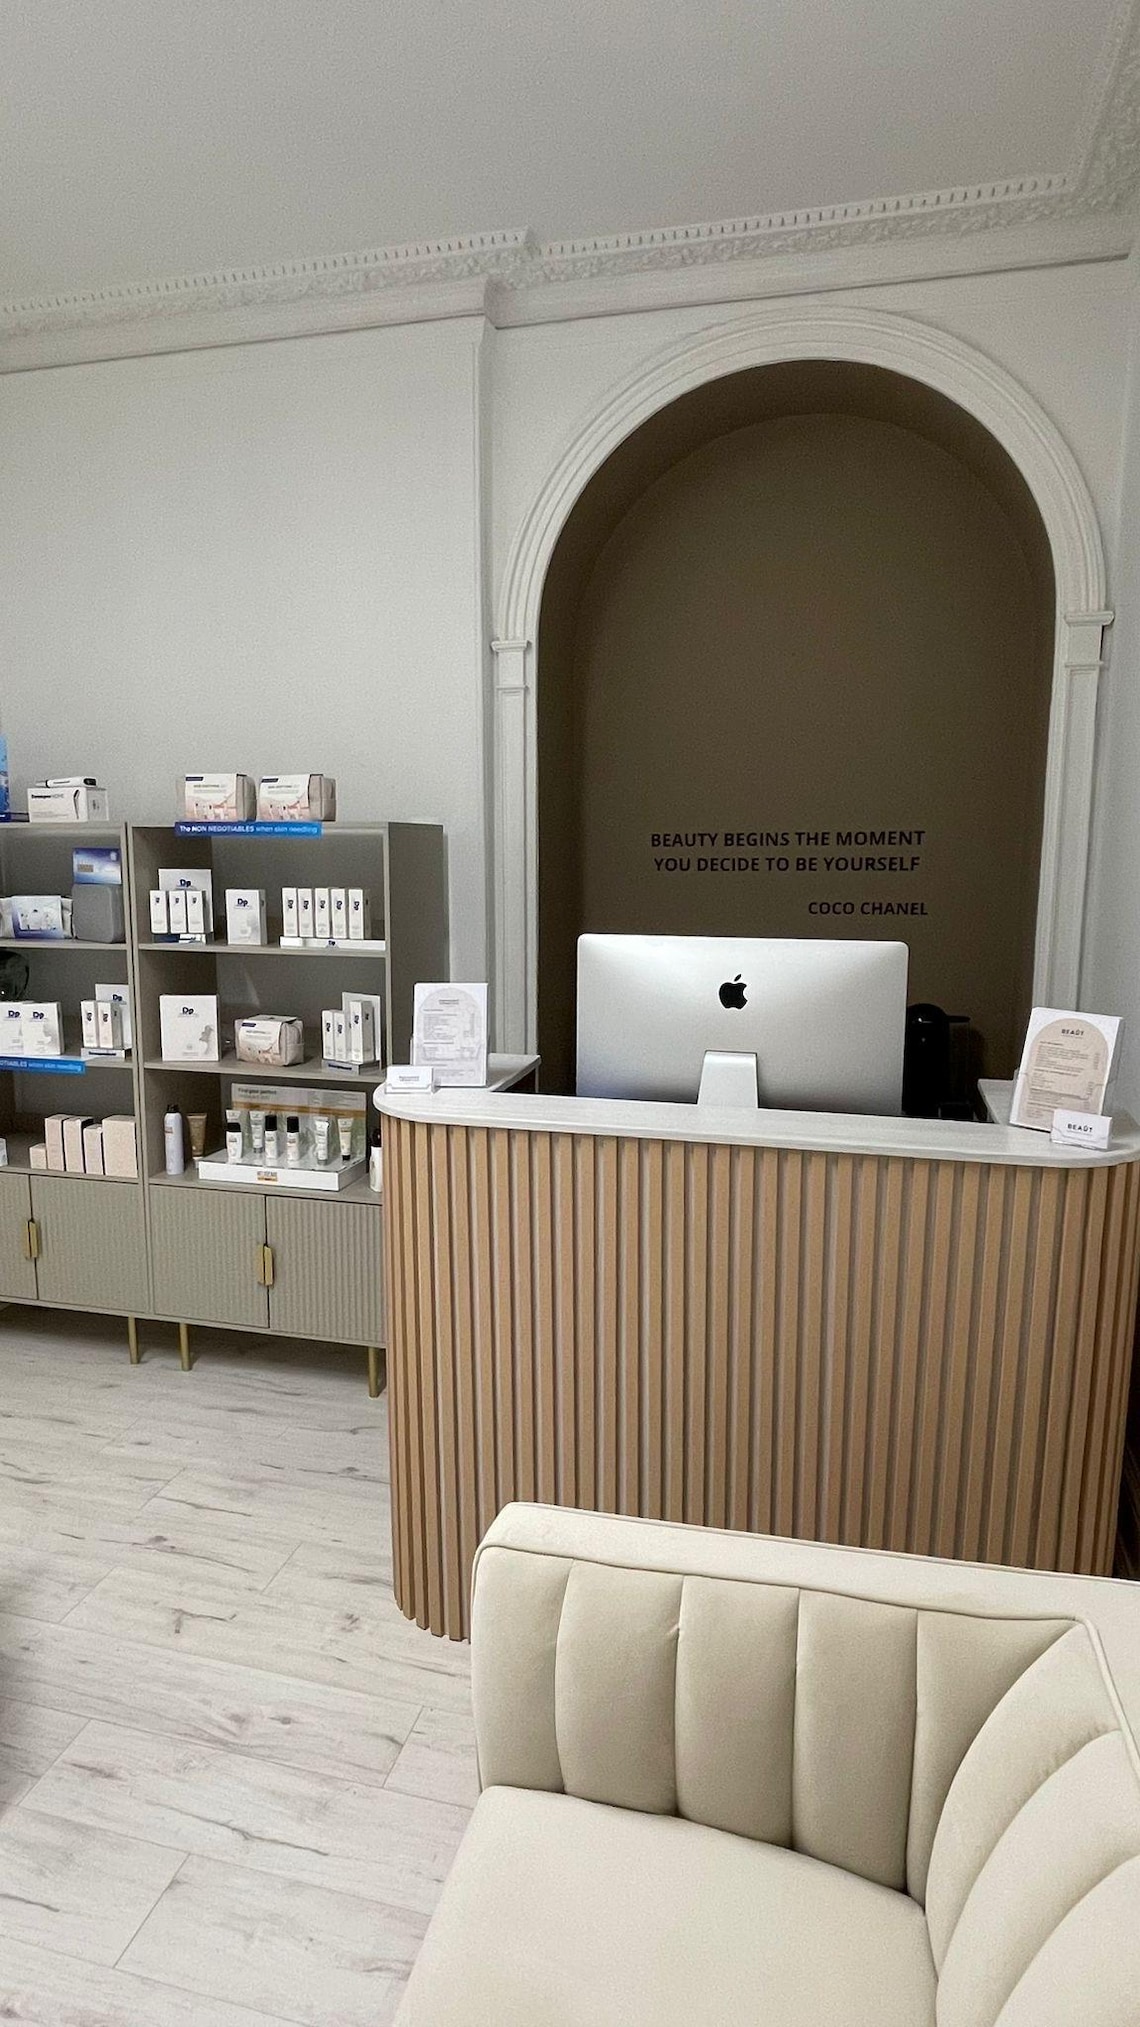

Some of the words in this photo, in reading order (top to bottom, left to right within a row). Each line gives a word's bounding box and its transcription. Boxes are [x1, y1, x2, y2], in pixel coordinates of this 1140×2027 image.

[180, 825, 190, 833] The
[208, 825, 254, 833] NEGOTIABLES
[651, 833, 718, 847] BEAUTY
[724, 832, 790, 847] BEGINS
[795, 832, 830, 846] THE
[836, 830, 926, 846] MOMENT
[654, 858, 691, 872] YOU
[697, 857, 760, 872] DECIDE
[765, 857, 790, 871] TO
[796, 857, 818, 871] BE
[824, 856, 920, 871] YOURSELF
[179, 879, 192, 887] Dp
[237, 898, 249, 907] Dp
[808, 901, 855, 915] COCO
[860, 901, 928, 915] CHANEL
